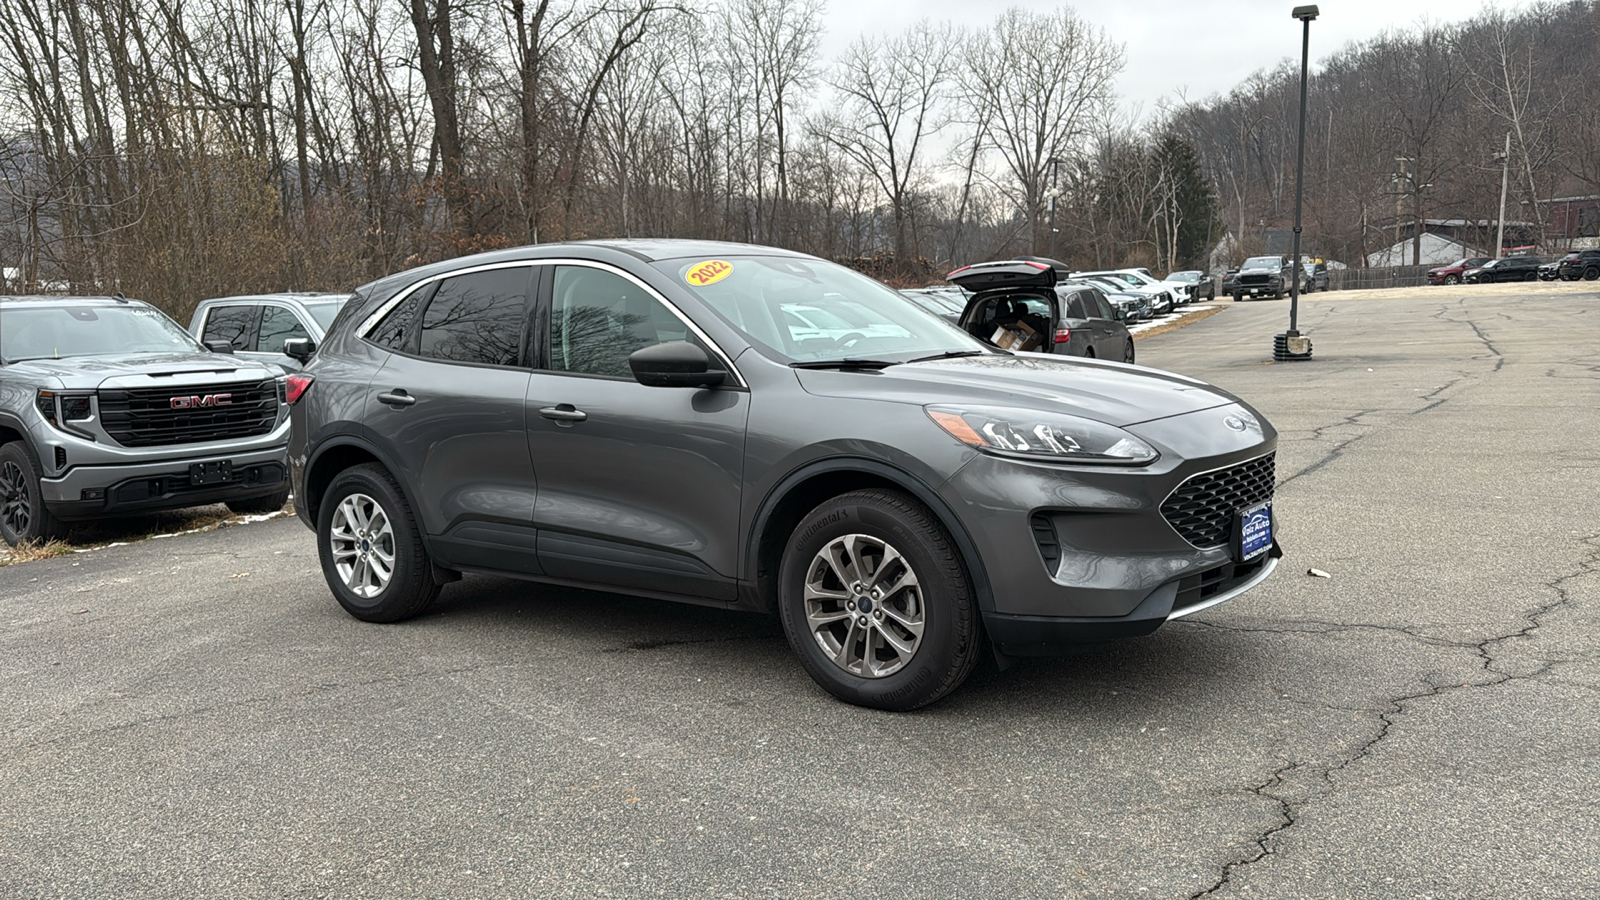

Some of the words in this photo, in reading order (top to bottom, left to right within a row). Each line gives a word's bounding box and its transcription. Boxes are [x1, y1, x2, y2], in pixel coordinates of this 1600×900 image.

[691, 261, 730, 284] 2022
[170, 393, 232, 409] GMC
[795, 510, 842, 551] Continental
[1255, 520, 1270, 532] Auto
[879, 666, 932, 702] Continental
